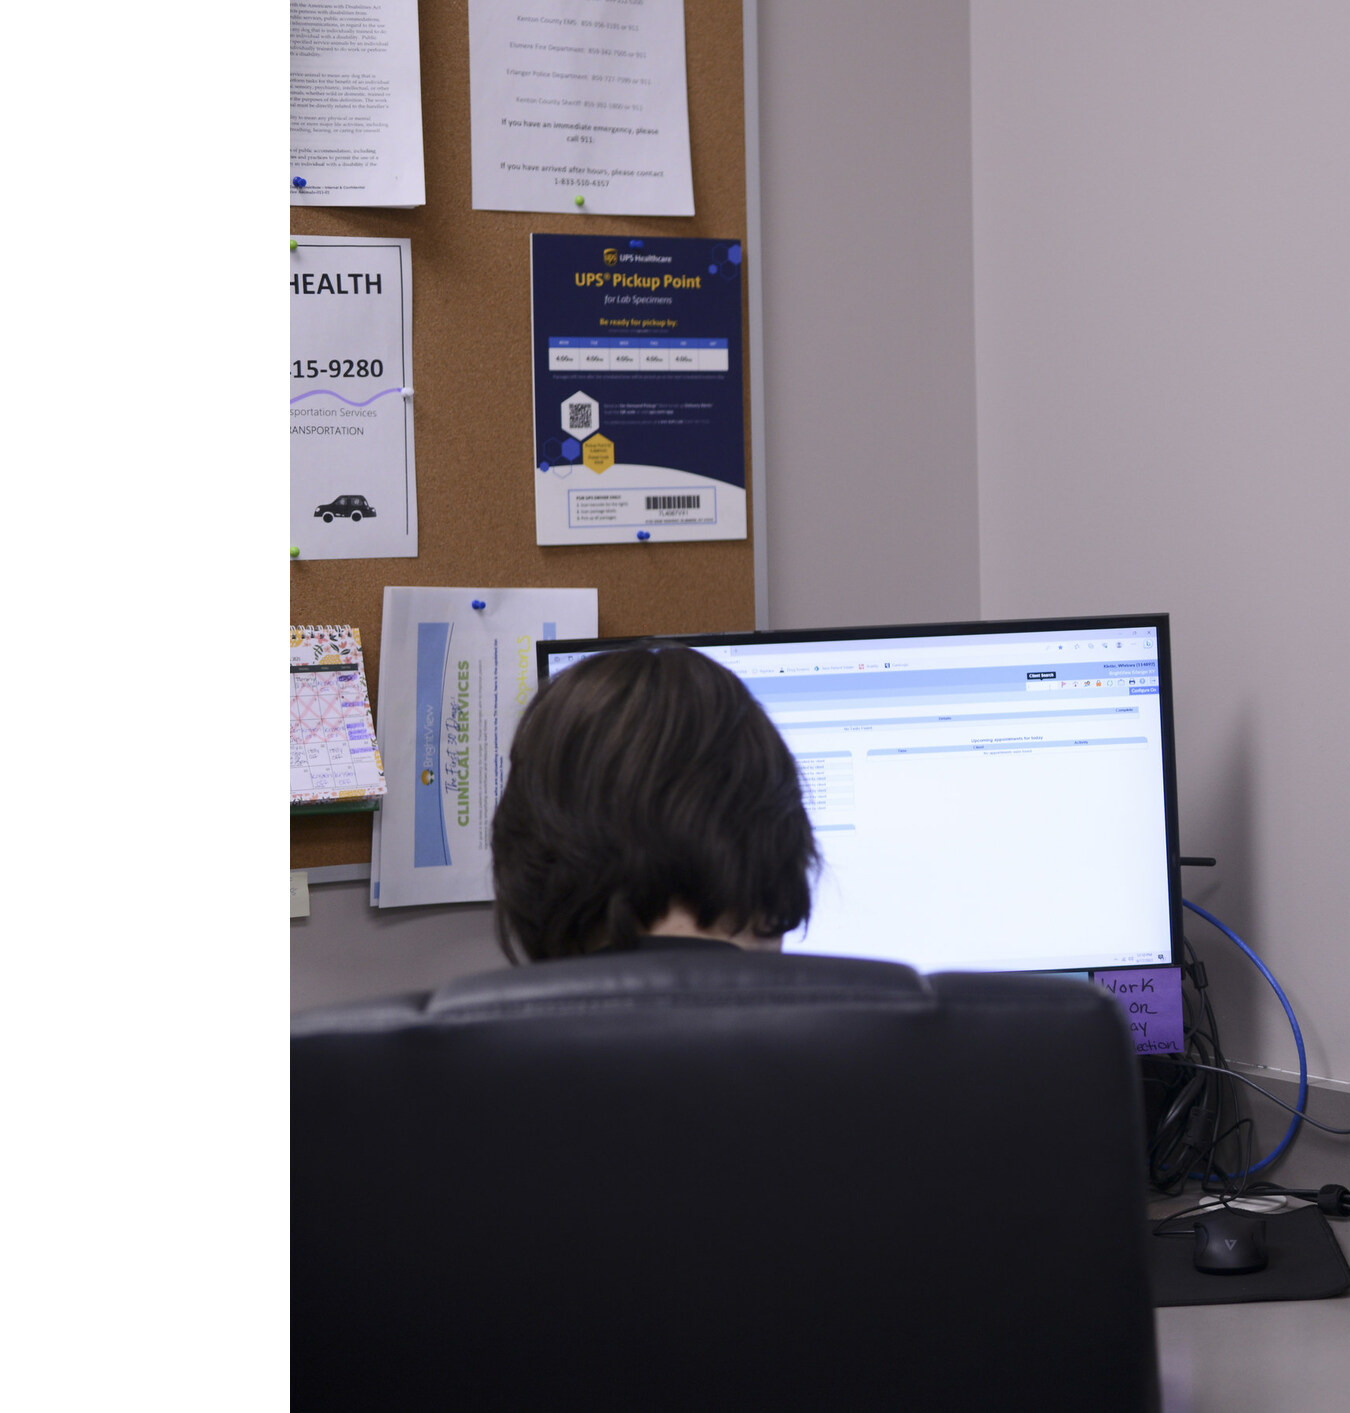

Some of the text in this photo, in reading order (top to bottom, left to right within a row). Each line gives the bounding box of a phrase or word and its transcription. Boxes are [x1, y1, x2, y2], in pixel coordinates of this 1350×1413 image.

[613, 273, 661, 291] Pickup
[664, 274, 702, 289] Point
[290, 358, 384, 378] 15-9280
[340, 407, 377, 418] Services
[423, 704, 436, 768] BrightView
[457, 660, 470, 827] CLINICAL SERVICES
